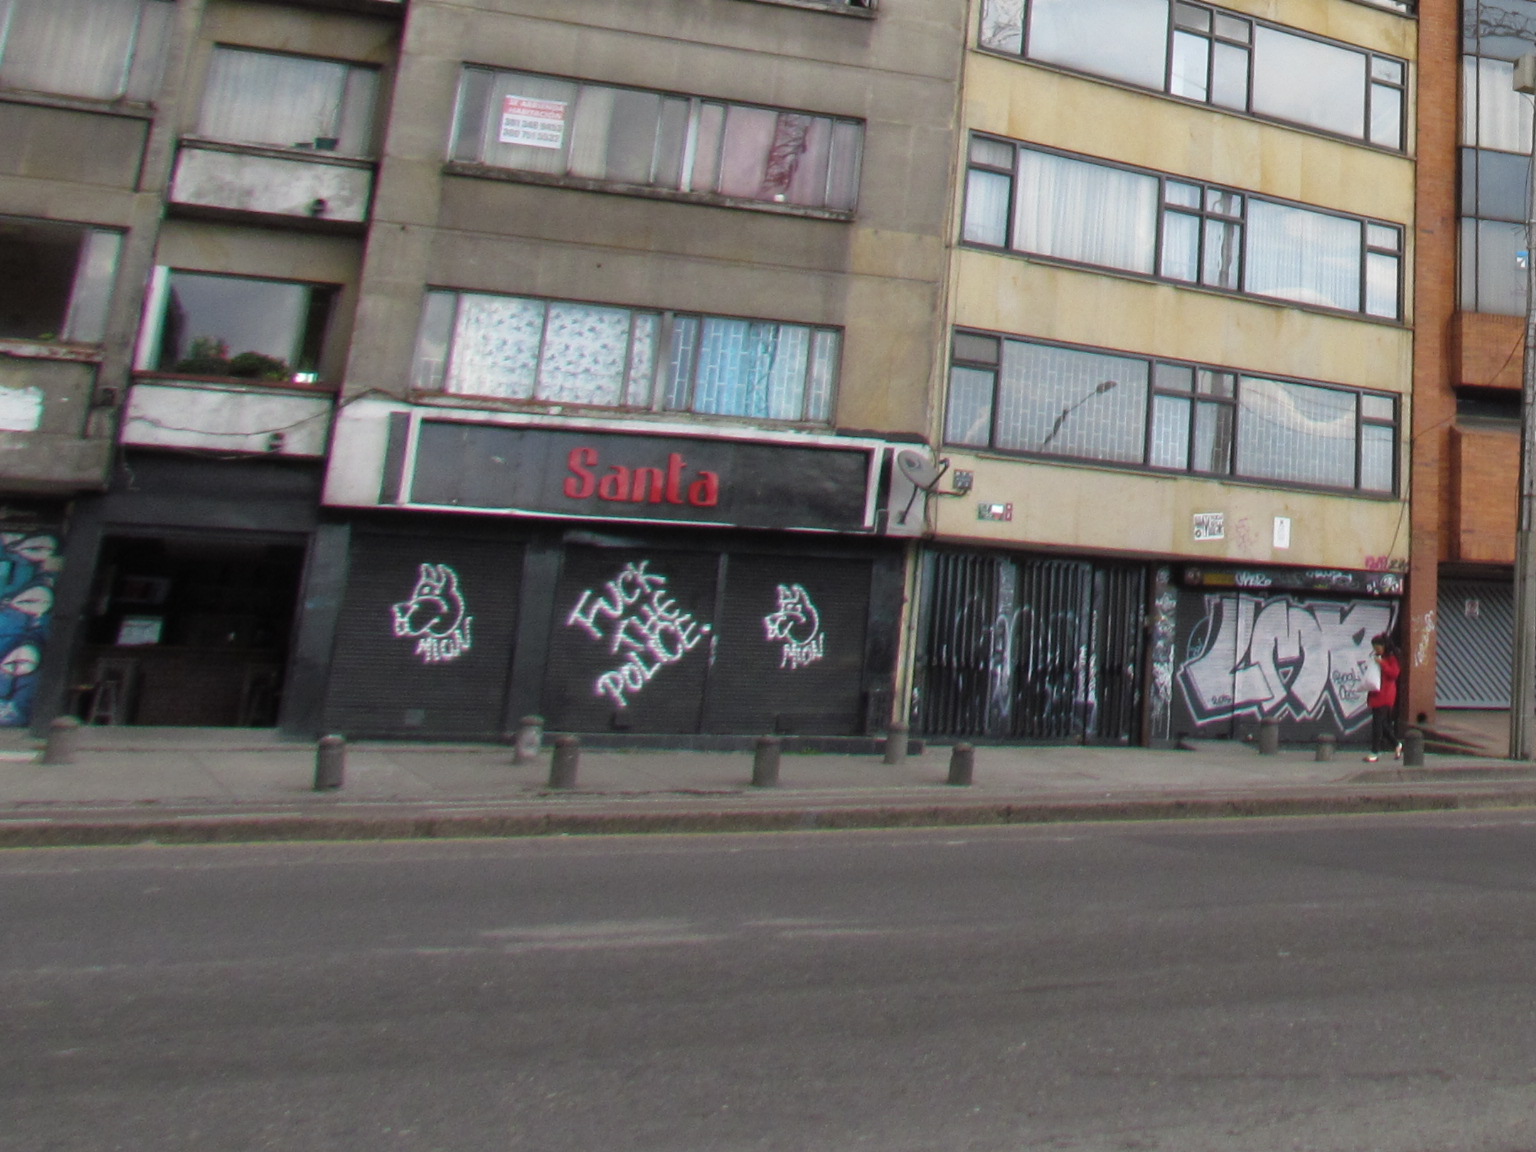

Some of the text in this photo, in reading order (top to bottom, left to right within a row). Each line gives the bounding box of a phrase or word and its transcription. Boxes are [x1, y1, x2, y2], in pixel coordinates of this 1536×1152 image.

[563, 447, 719, 507] Santa
[566, 560, 667, 639] FUCK
[610, 589, 681, 654] THE
